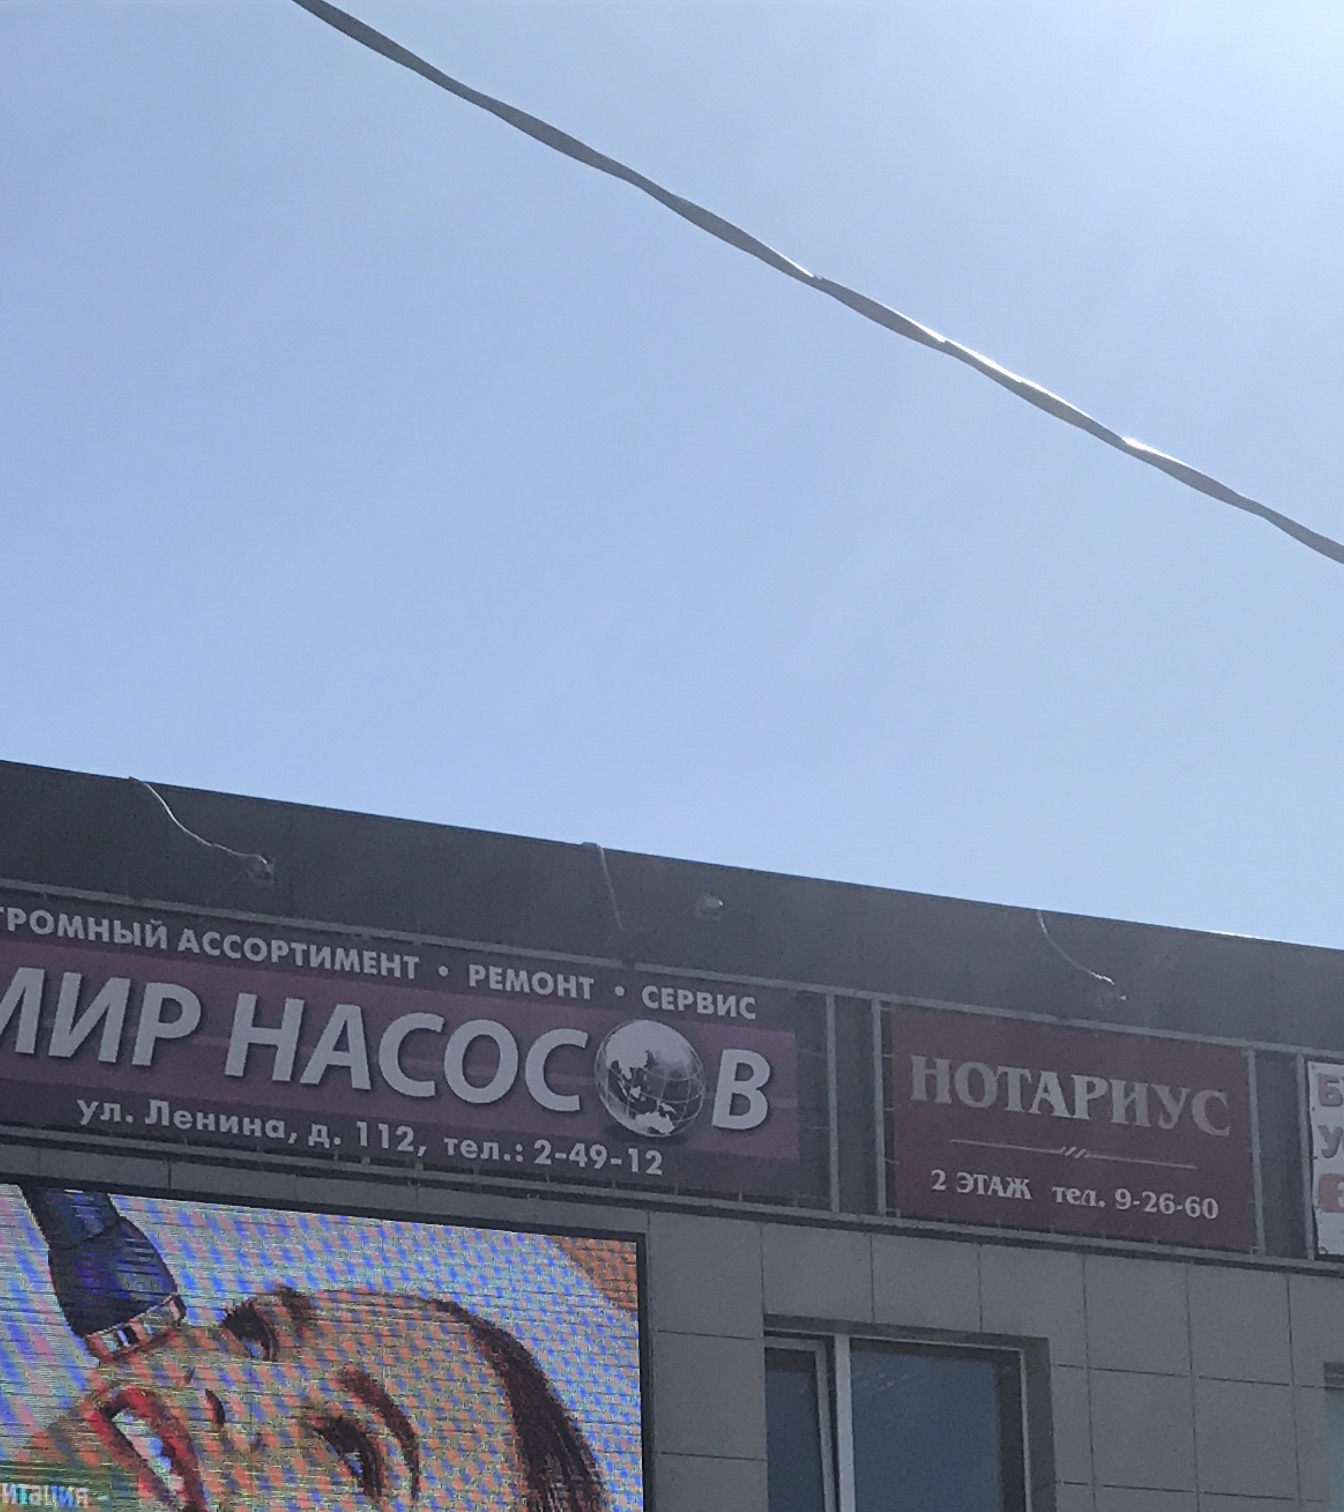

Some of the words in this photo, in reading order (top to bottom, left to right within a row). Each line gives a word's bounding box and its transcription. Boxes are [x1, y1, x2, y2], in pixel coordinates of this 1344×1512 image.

[178, 930, 419, 980] АССОРТИМЕНТ
[468, 964, 594, 1001] РЕМОНТ
[642, 984, 757, 1020] СЕРВИС
[910, 1055, 1232, 1138] НОТАРИУС
[77, 1098, 134, 1125] ул.
[146, 1099, 297, 1145] Ленина,
[309, 1119, 342, 1149] д.
[356, 1120, 427, 1156] 112,
[533, 1139, 664, 1177] 2-49-12
[931, 1169, 947, 1191] 2
[955, 1174, 1032, 1201] ЭТАЖ
[1052, 1183, 1107, 1209] тел.
[1114, 1185, 1219, 1221] 9-26-60
